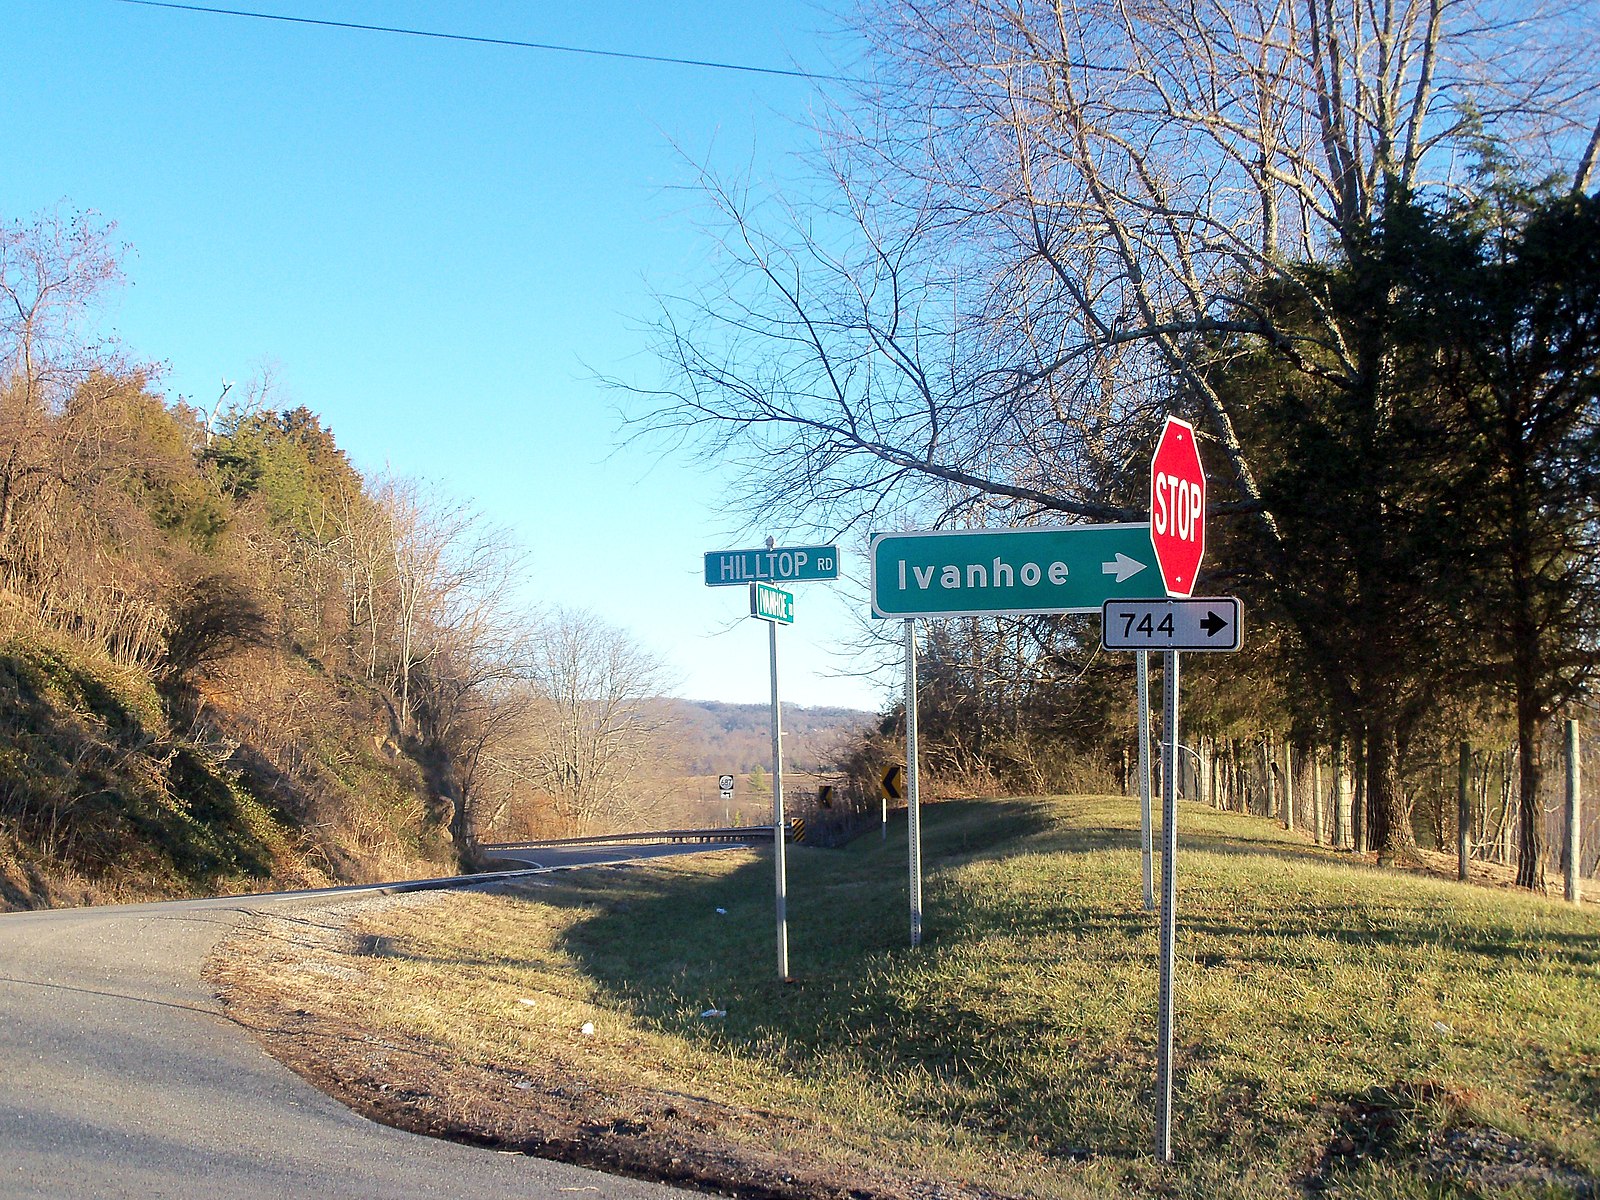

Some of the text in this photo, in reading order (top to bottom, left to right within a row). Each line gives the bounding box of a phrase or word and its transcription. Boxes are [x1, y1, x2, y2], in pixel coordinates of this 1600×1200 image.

[1155, 471, 1202, 543] STOP
[720, 551, 833, 580] HILLTOP RD
[898, 556, 1069, 590] Ivanhoe
[1119, 613, 1175, 638] 744
